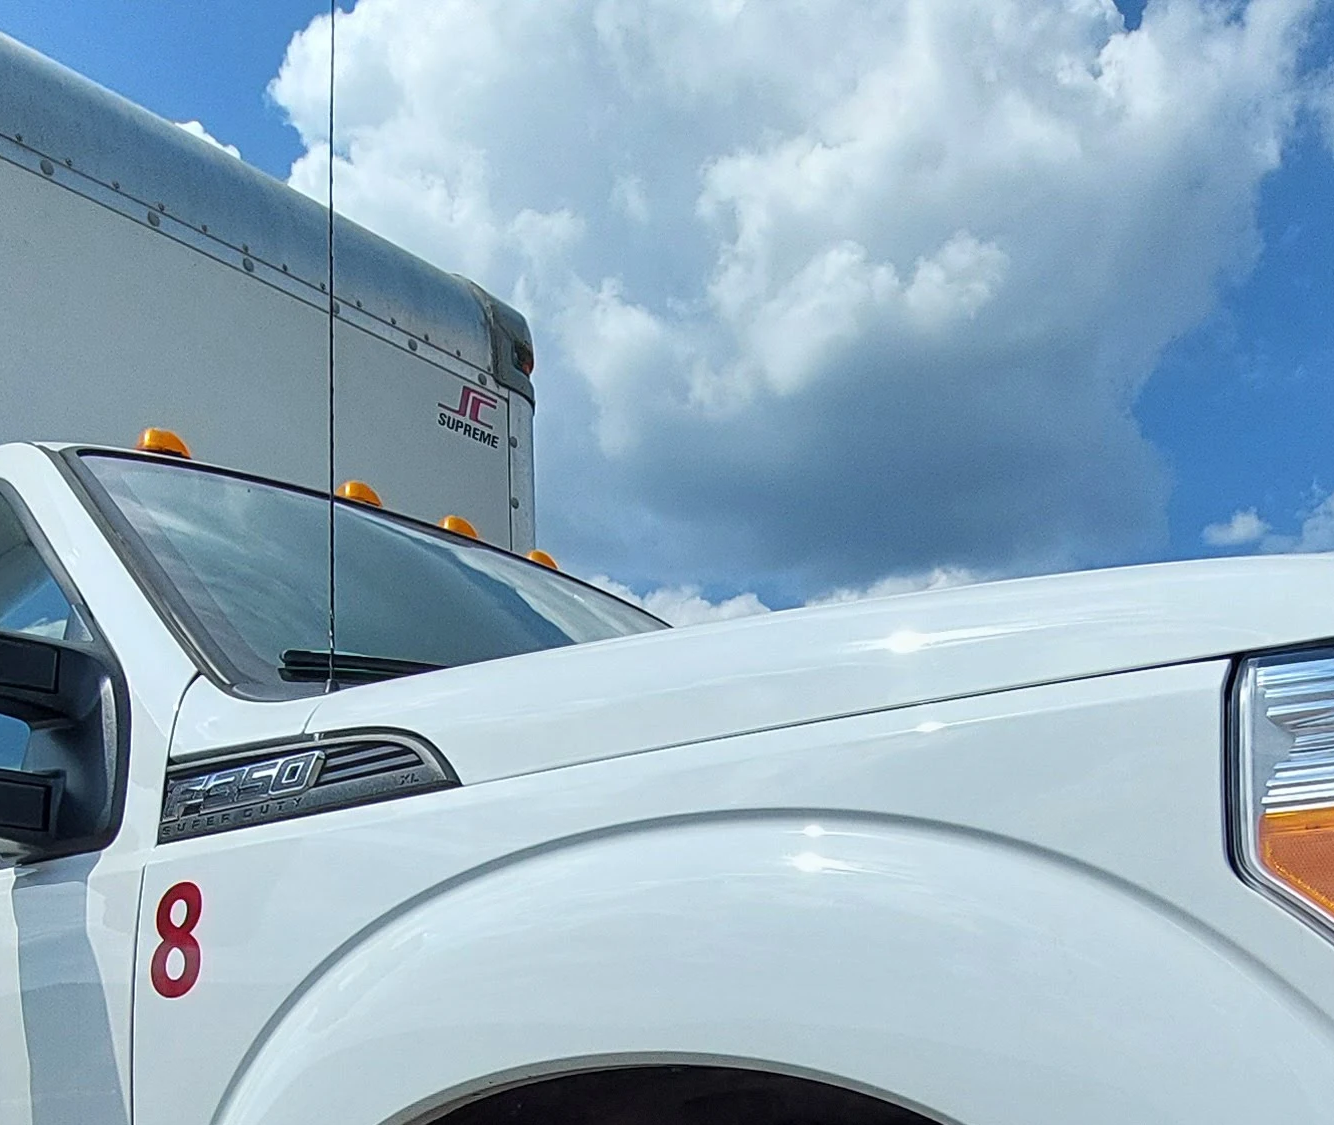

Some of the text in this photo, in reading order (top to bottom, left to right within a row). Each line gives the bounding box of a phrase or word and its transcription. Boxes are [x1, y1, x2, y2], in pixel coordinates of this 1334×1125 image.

[437, 412, 500, 449] SUPREME
[399, 772, 420, 786] XL
[150, 881, 203, 999] 8
